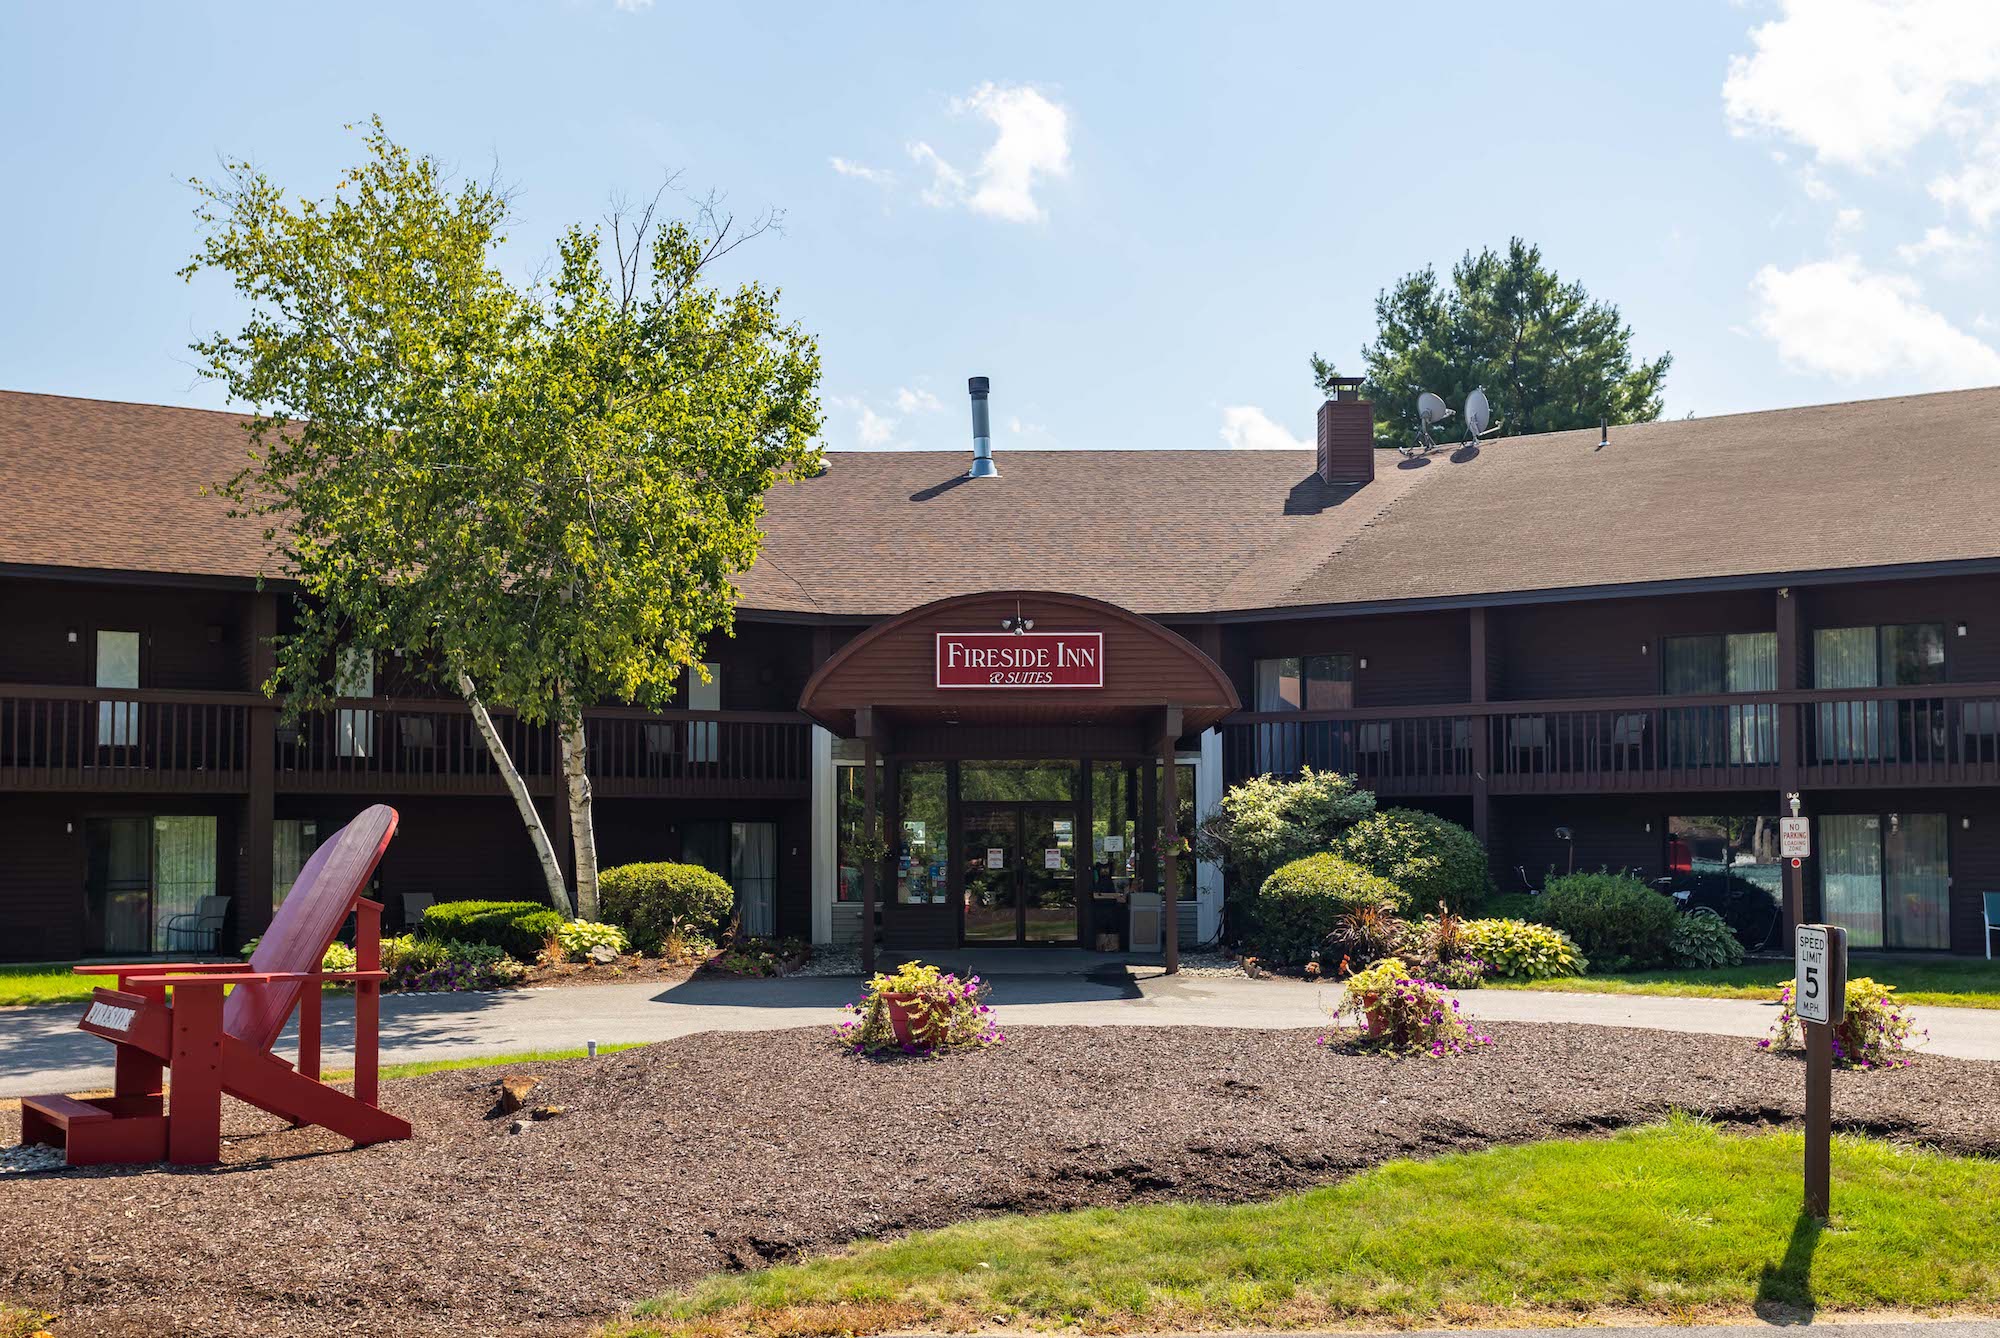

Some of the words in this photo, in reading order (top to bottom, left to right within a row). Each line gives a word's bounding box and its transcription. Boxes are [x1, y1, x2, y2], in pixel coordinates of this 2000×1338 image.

[947, 642, 1050, 668] FIRESIDE
[1057, 642, 1095, 668] INN
[989, 672, 1004, 684] &
[1005, 671, 1053, 684] SUITES
[1789, 823, 1800, 831] NO
[1783, 831, 1807, 840] PARKING
[1799, 936, 1825, 950] SPEED
[1802, 950, 1822, 964] LIMIT
[1805, 966, 1819, 999] 5
